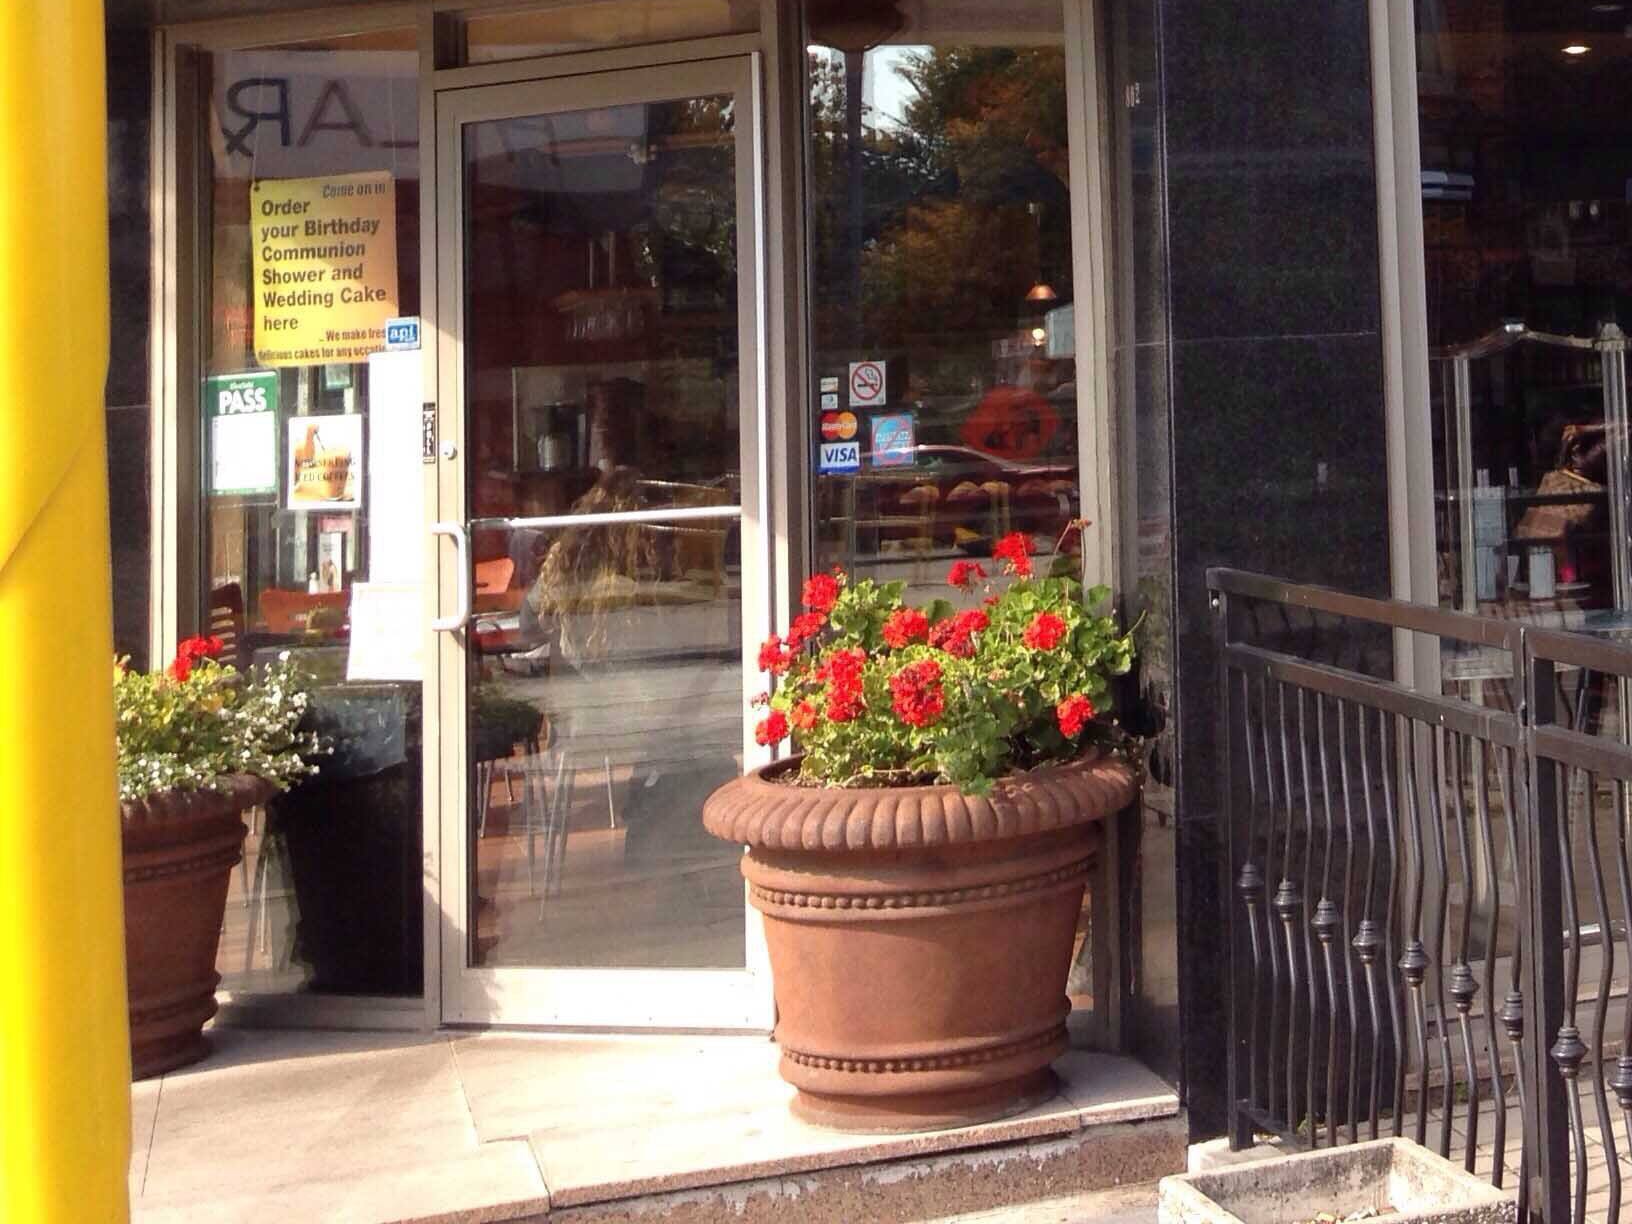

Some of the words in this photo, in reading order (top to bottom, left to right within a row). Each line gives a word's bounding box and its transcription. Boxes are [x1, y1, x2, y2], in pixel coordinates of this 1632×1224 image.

[356, 184, 372, 195] on
[261, 200, 311, 216] Order
[261, 225, 298, 242] your
[304, 217, 380, 237] Birthday
[262, 242, 366, 262] Communion
[262, 268, 326, 285] Shower
[331, 263, 363, 281] and
[263, 290, 334, 308] Wedding
[340, 286, 387, 304] Cake
[263, 316, 299, 331] here
[342, 329, 367, 340] make
[368, 327, 386, 339] fres
[294, 348, 320, 359] cakes
[322, 346, 334, 358] for
[219, 387, 267, 414] PASS
[825, 447, 858, 463] VISA
